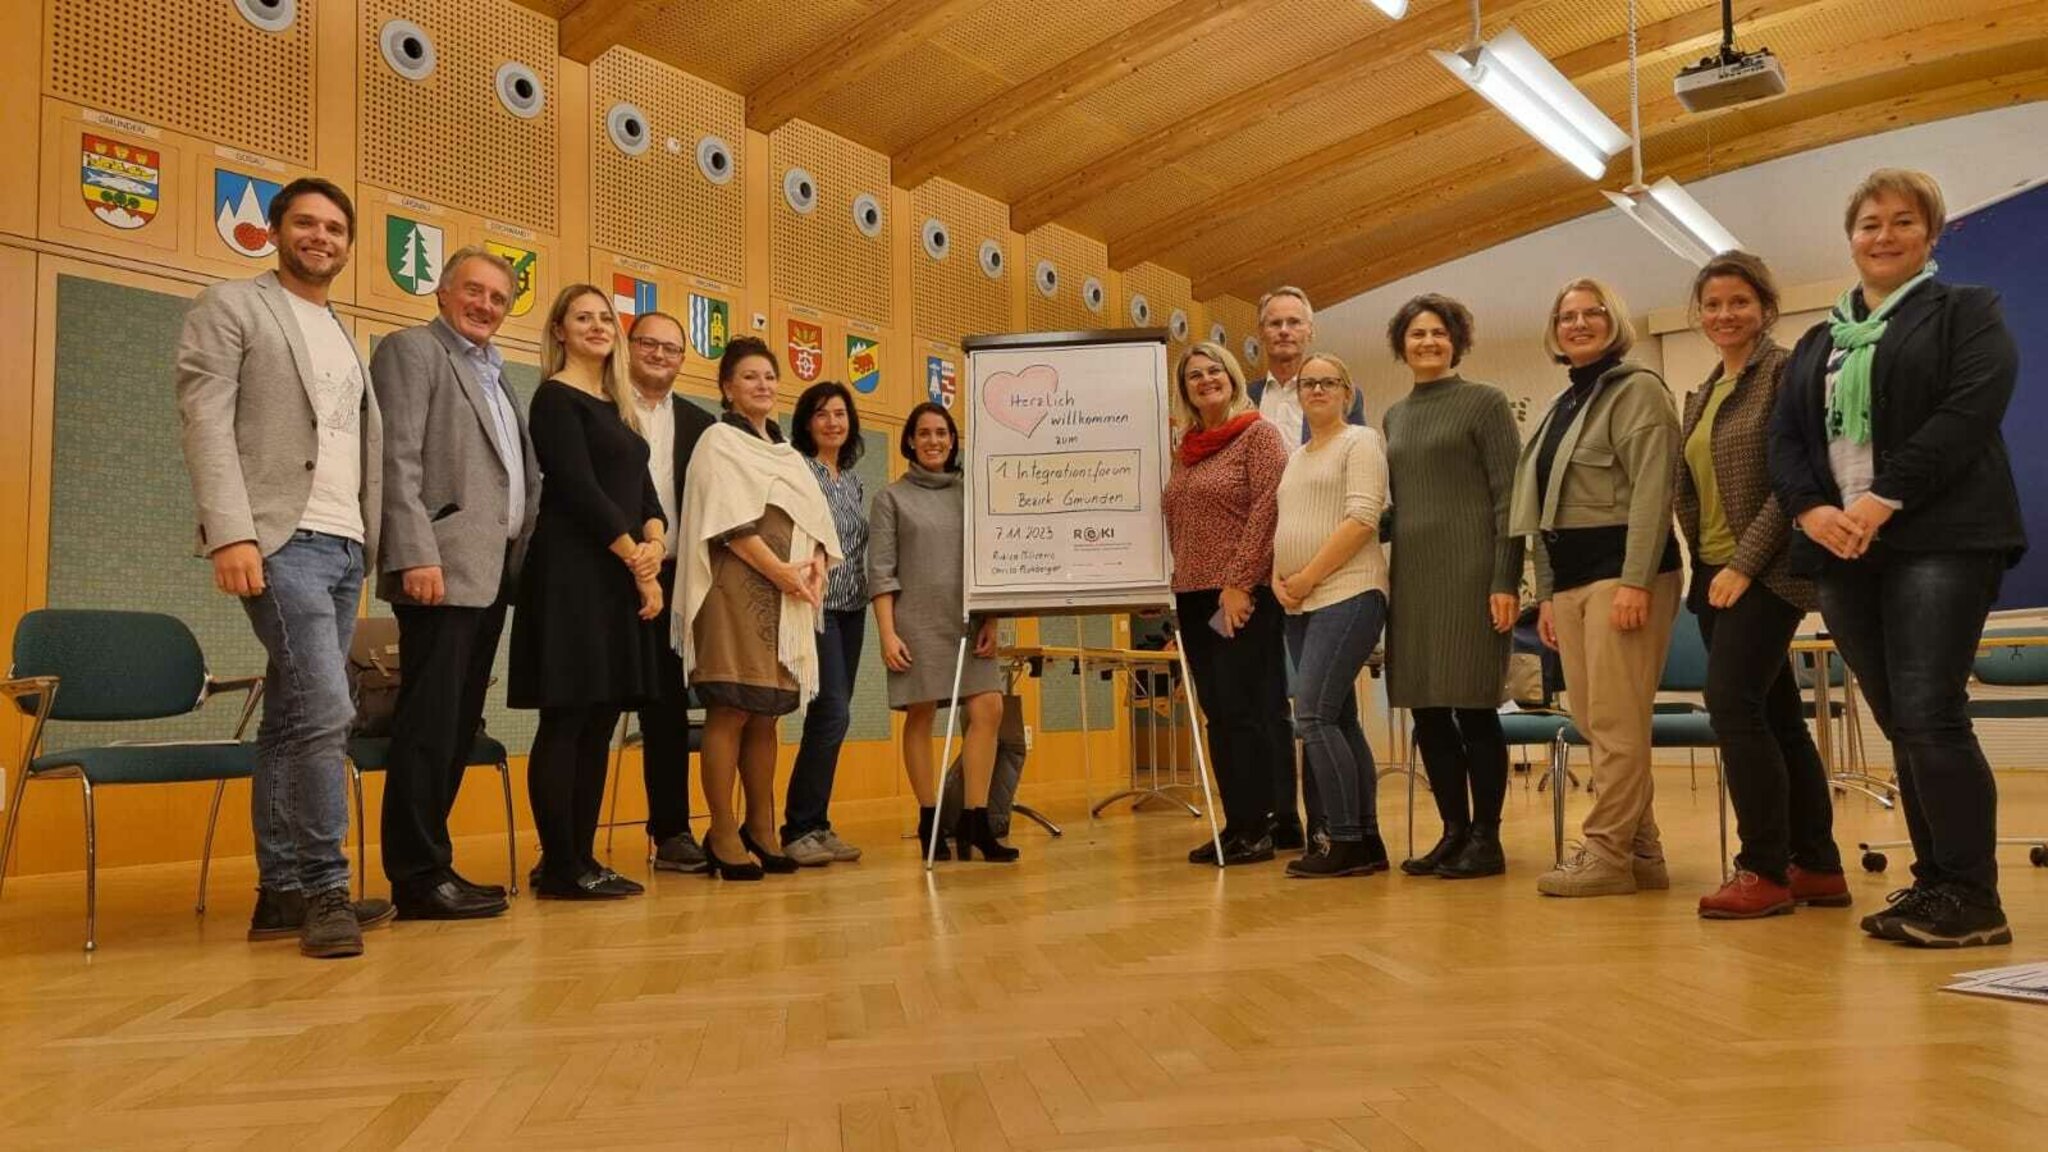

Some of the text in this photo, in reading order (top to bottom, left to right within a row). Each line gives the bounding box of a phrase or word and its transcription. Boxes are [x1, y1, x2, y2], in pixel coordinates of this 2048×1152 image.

[98, 114, 146, 134] GMUNDEN
[1010, 389, 1075, 408] Herzlich
[1050, 410, 1130, 426] willkommen
[1055, 436, 1079, 446] zum
[1016, 459, 1132, 485] Integrationsforum
[1018, 489, 1124, 509] Bezirk Gmunden
